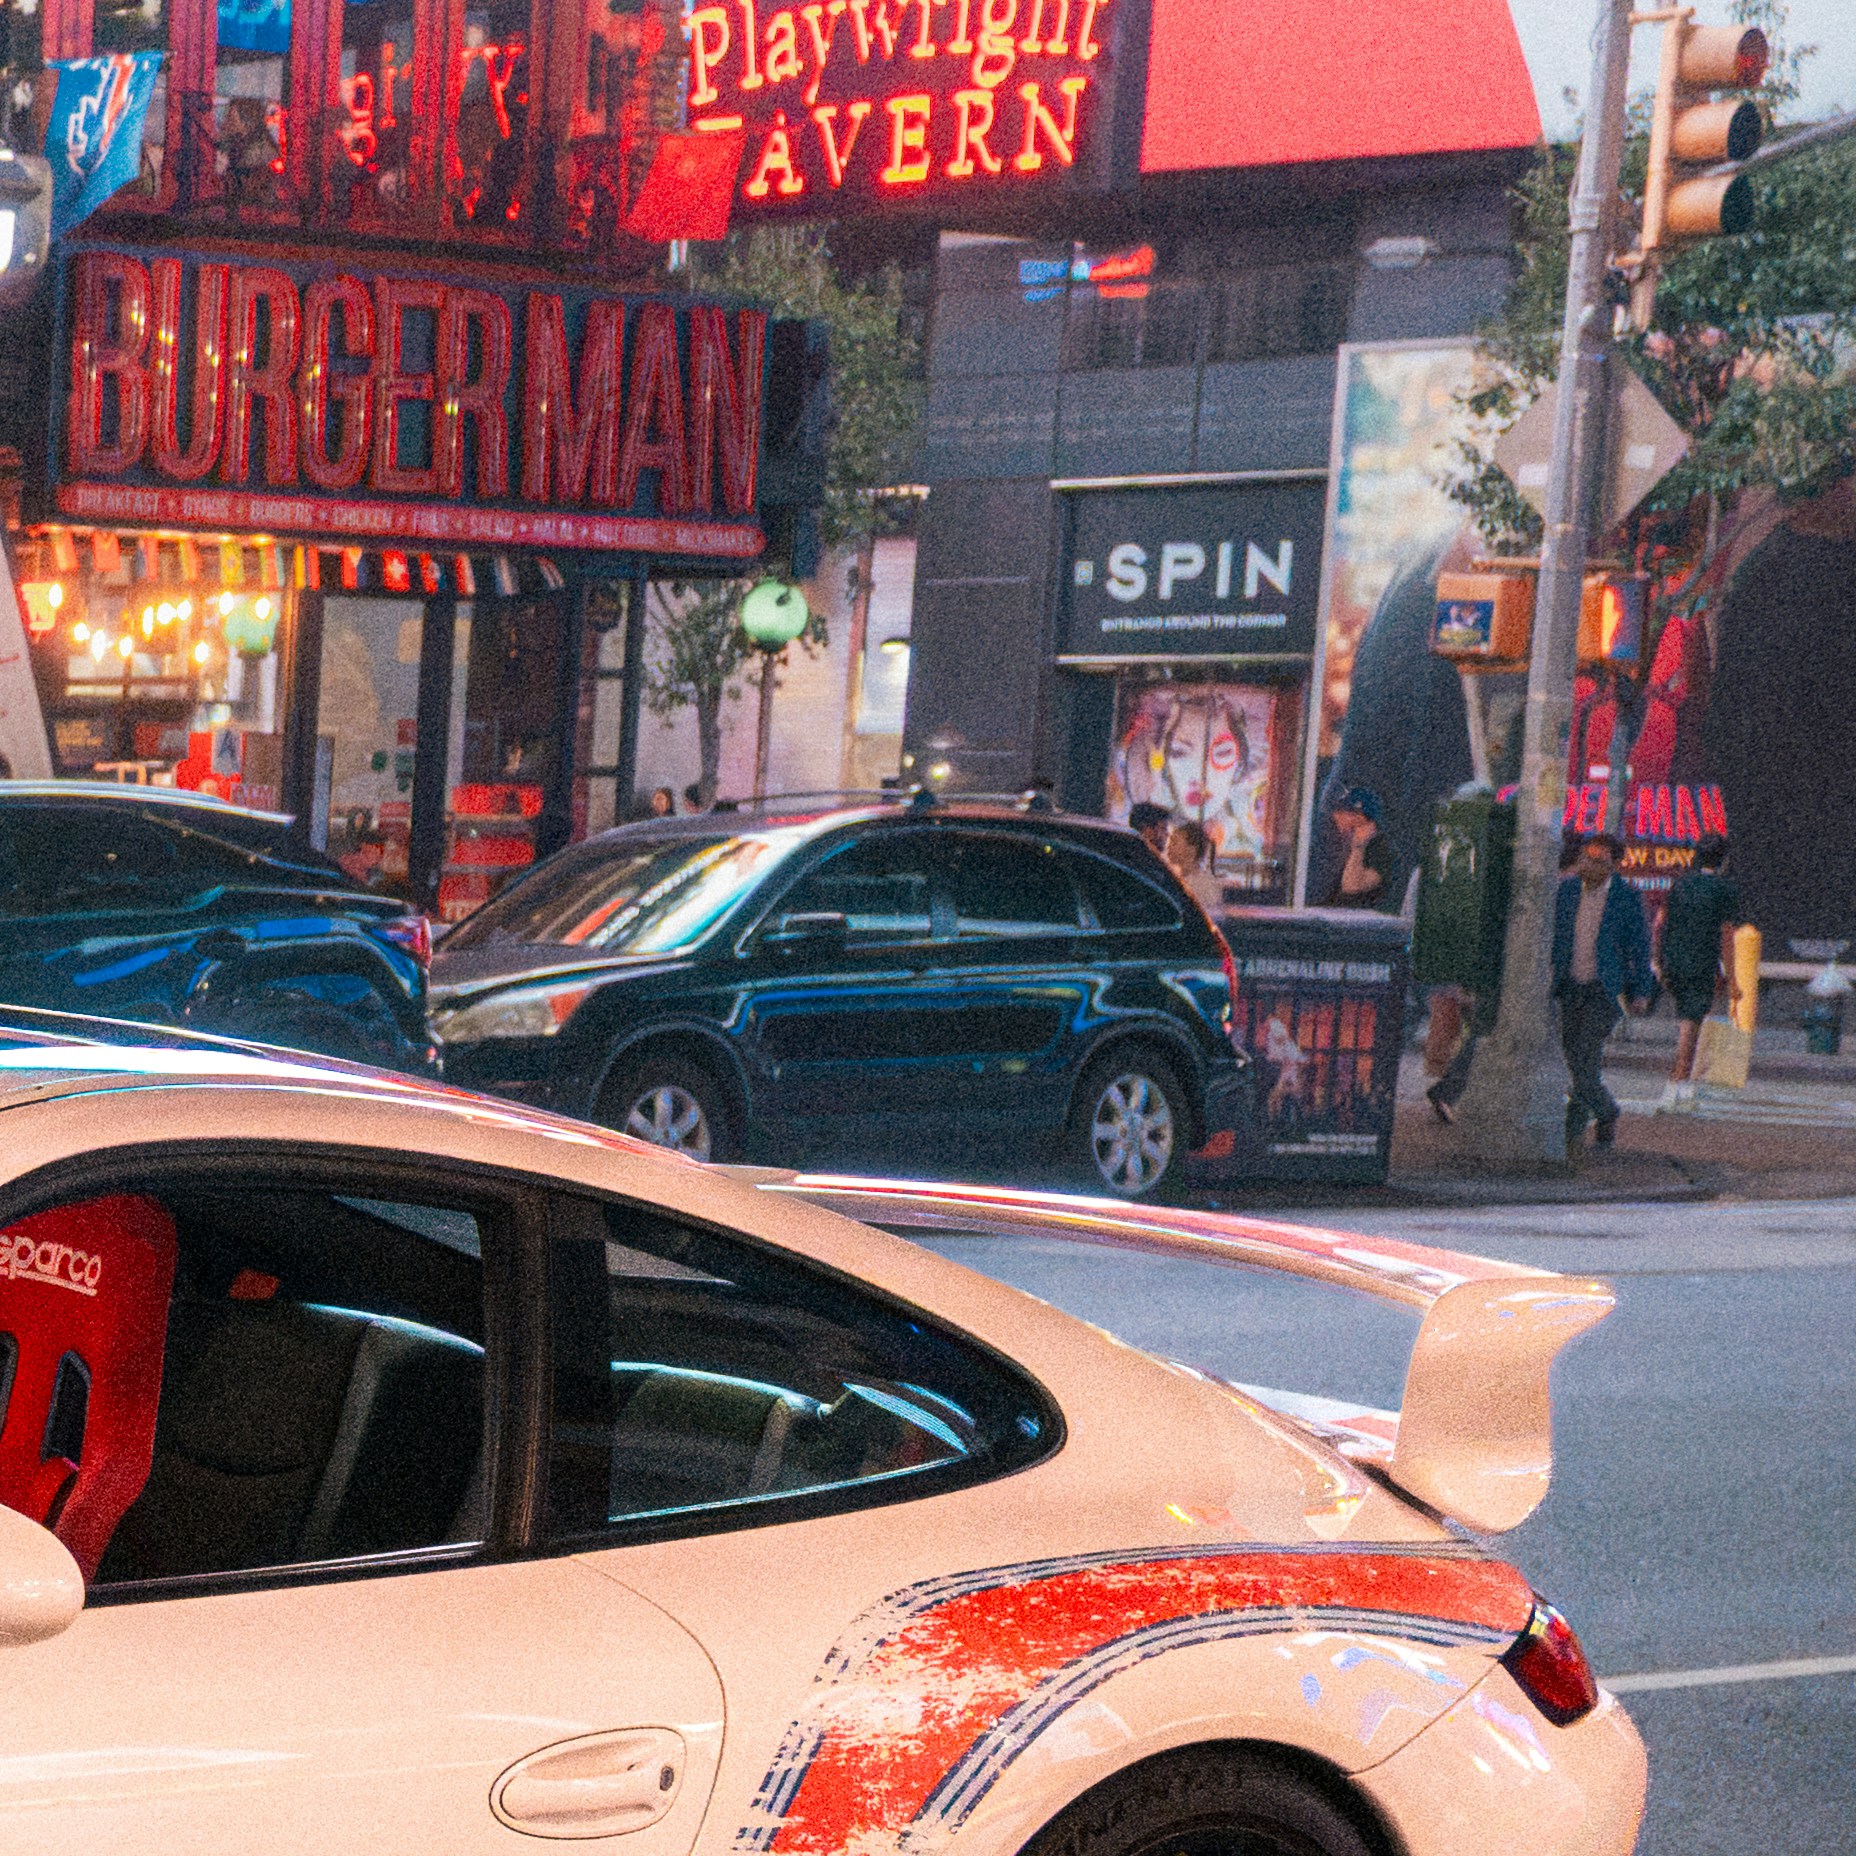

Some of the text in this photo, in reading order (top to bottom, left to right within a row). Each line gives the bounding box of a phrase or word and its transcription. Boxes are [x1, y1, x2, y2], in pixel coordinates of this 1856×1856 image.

[694, 77, 1088, 197] AVERN
[69, 251, 767, 515] BURGER MAN
[76, 488, 160, 513] BREAKFAST
[249, 498, 313, 524] BURGERS
[331, 504, 393, 528] CHICKEN
[410, 509, 449, 531] FRIES
[1106, 539, 1294, 603] SPIN
[1654, 846, 1696, 869] DAY
